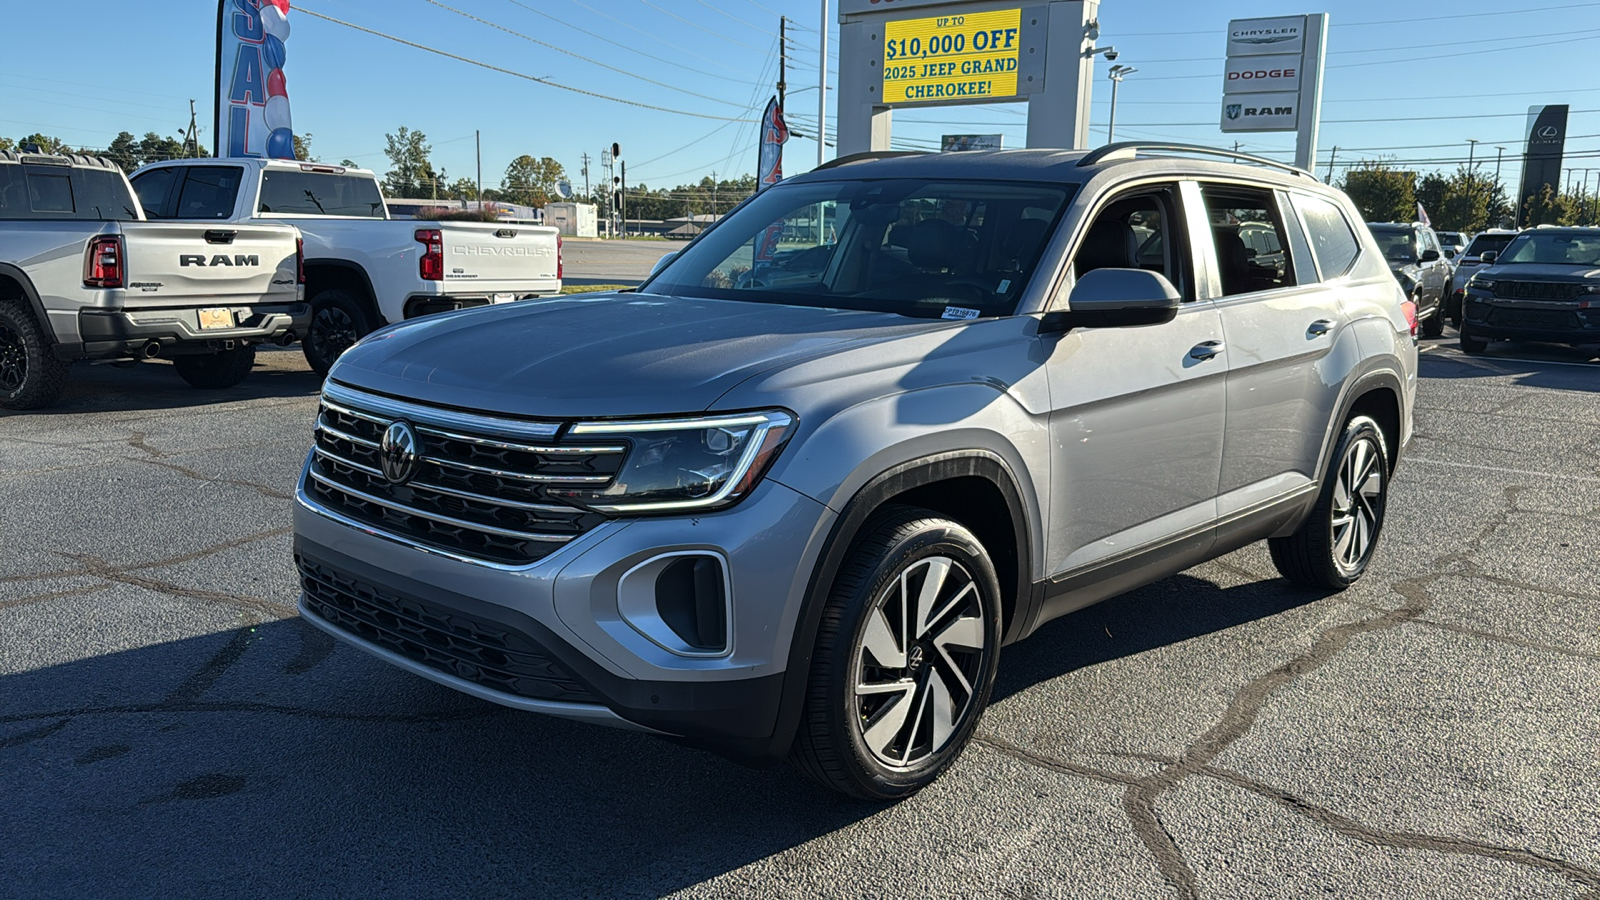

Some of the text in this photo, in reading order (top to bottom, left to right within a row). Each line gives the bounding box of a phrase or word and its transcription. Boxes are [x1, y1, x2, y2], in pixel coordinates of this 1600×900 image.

[936, 16, 965, 27] UP TO
[1232, 27, 1298, 37] CHRYSLER
[887, 28, 1017, 59] $10,000 OFF
[884, 57, 1017, 80] 2025 JEEP GRAND
[1228, 68, 1296, 81] DODGE
[905, 81, 991, 98] CHEROKEE!
[1244, 106, 1293, 117] RAM
[452, 245, 552, 257] CHEVROLET
[180, 254, 259, 266] RAM
